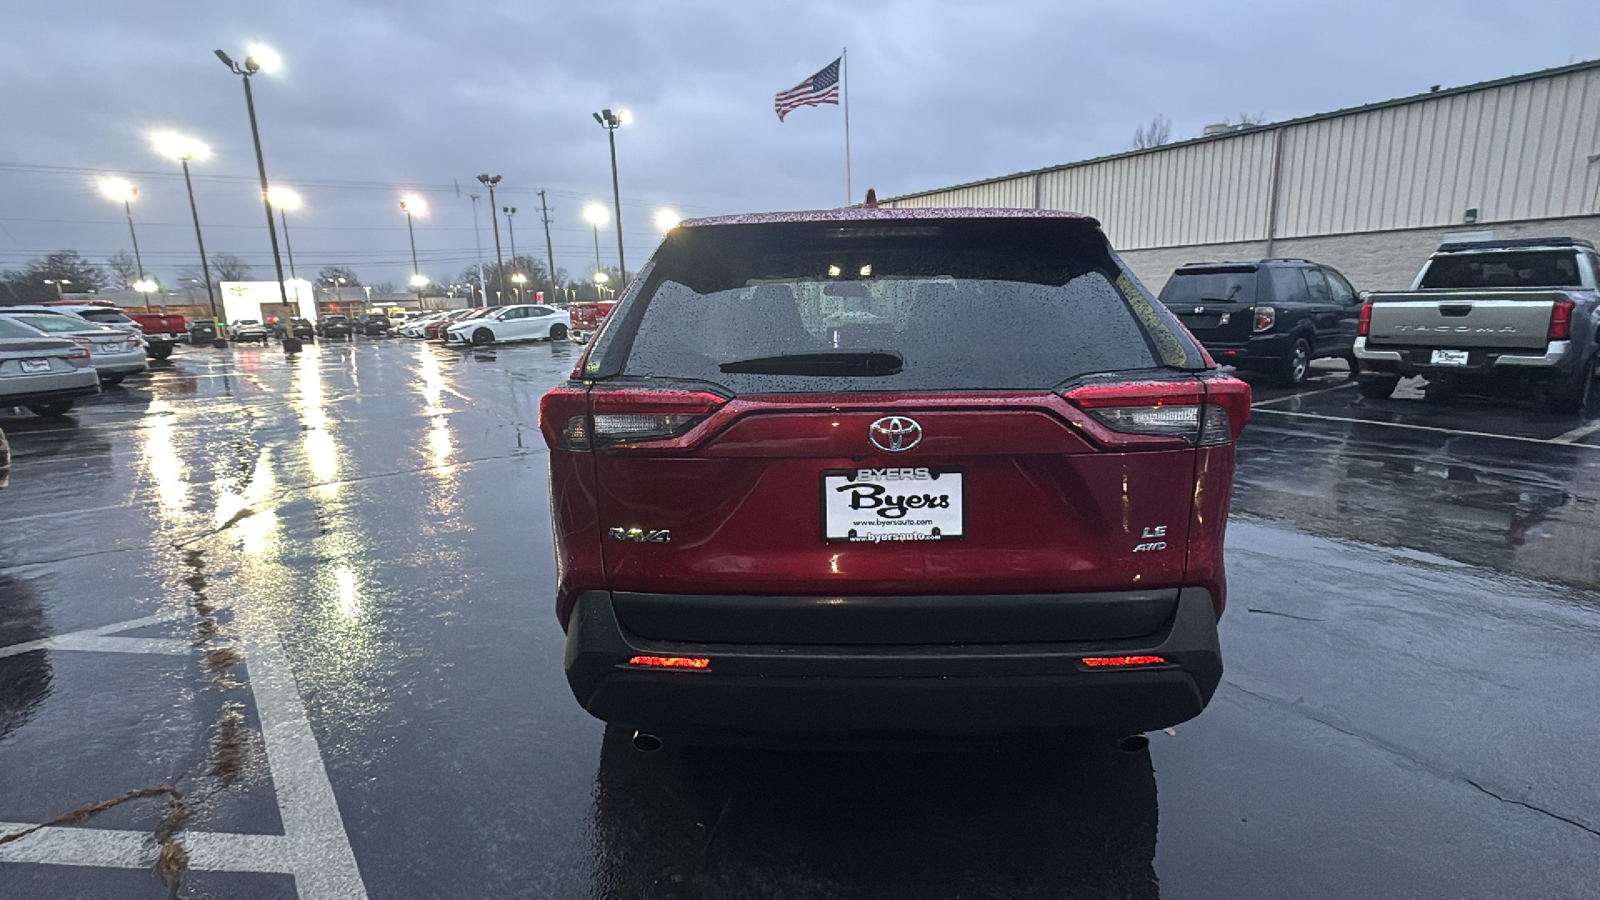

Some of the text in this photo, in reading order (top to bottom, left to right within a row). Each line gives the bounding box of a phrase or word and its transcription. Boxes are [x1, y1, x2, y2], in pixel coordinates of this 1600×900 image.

[857, 467, 930, 482] BYERS
[836, 483, 950, 519] Byers
[853, 518, 933, 527] www.byersauto.com
[849, 531, 941, 544] www.byersauto.com
[1141, 525, 1167, 539] LE
